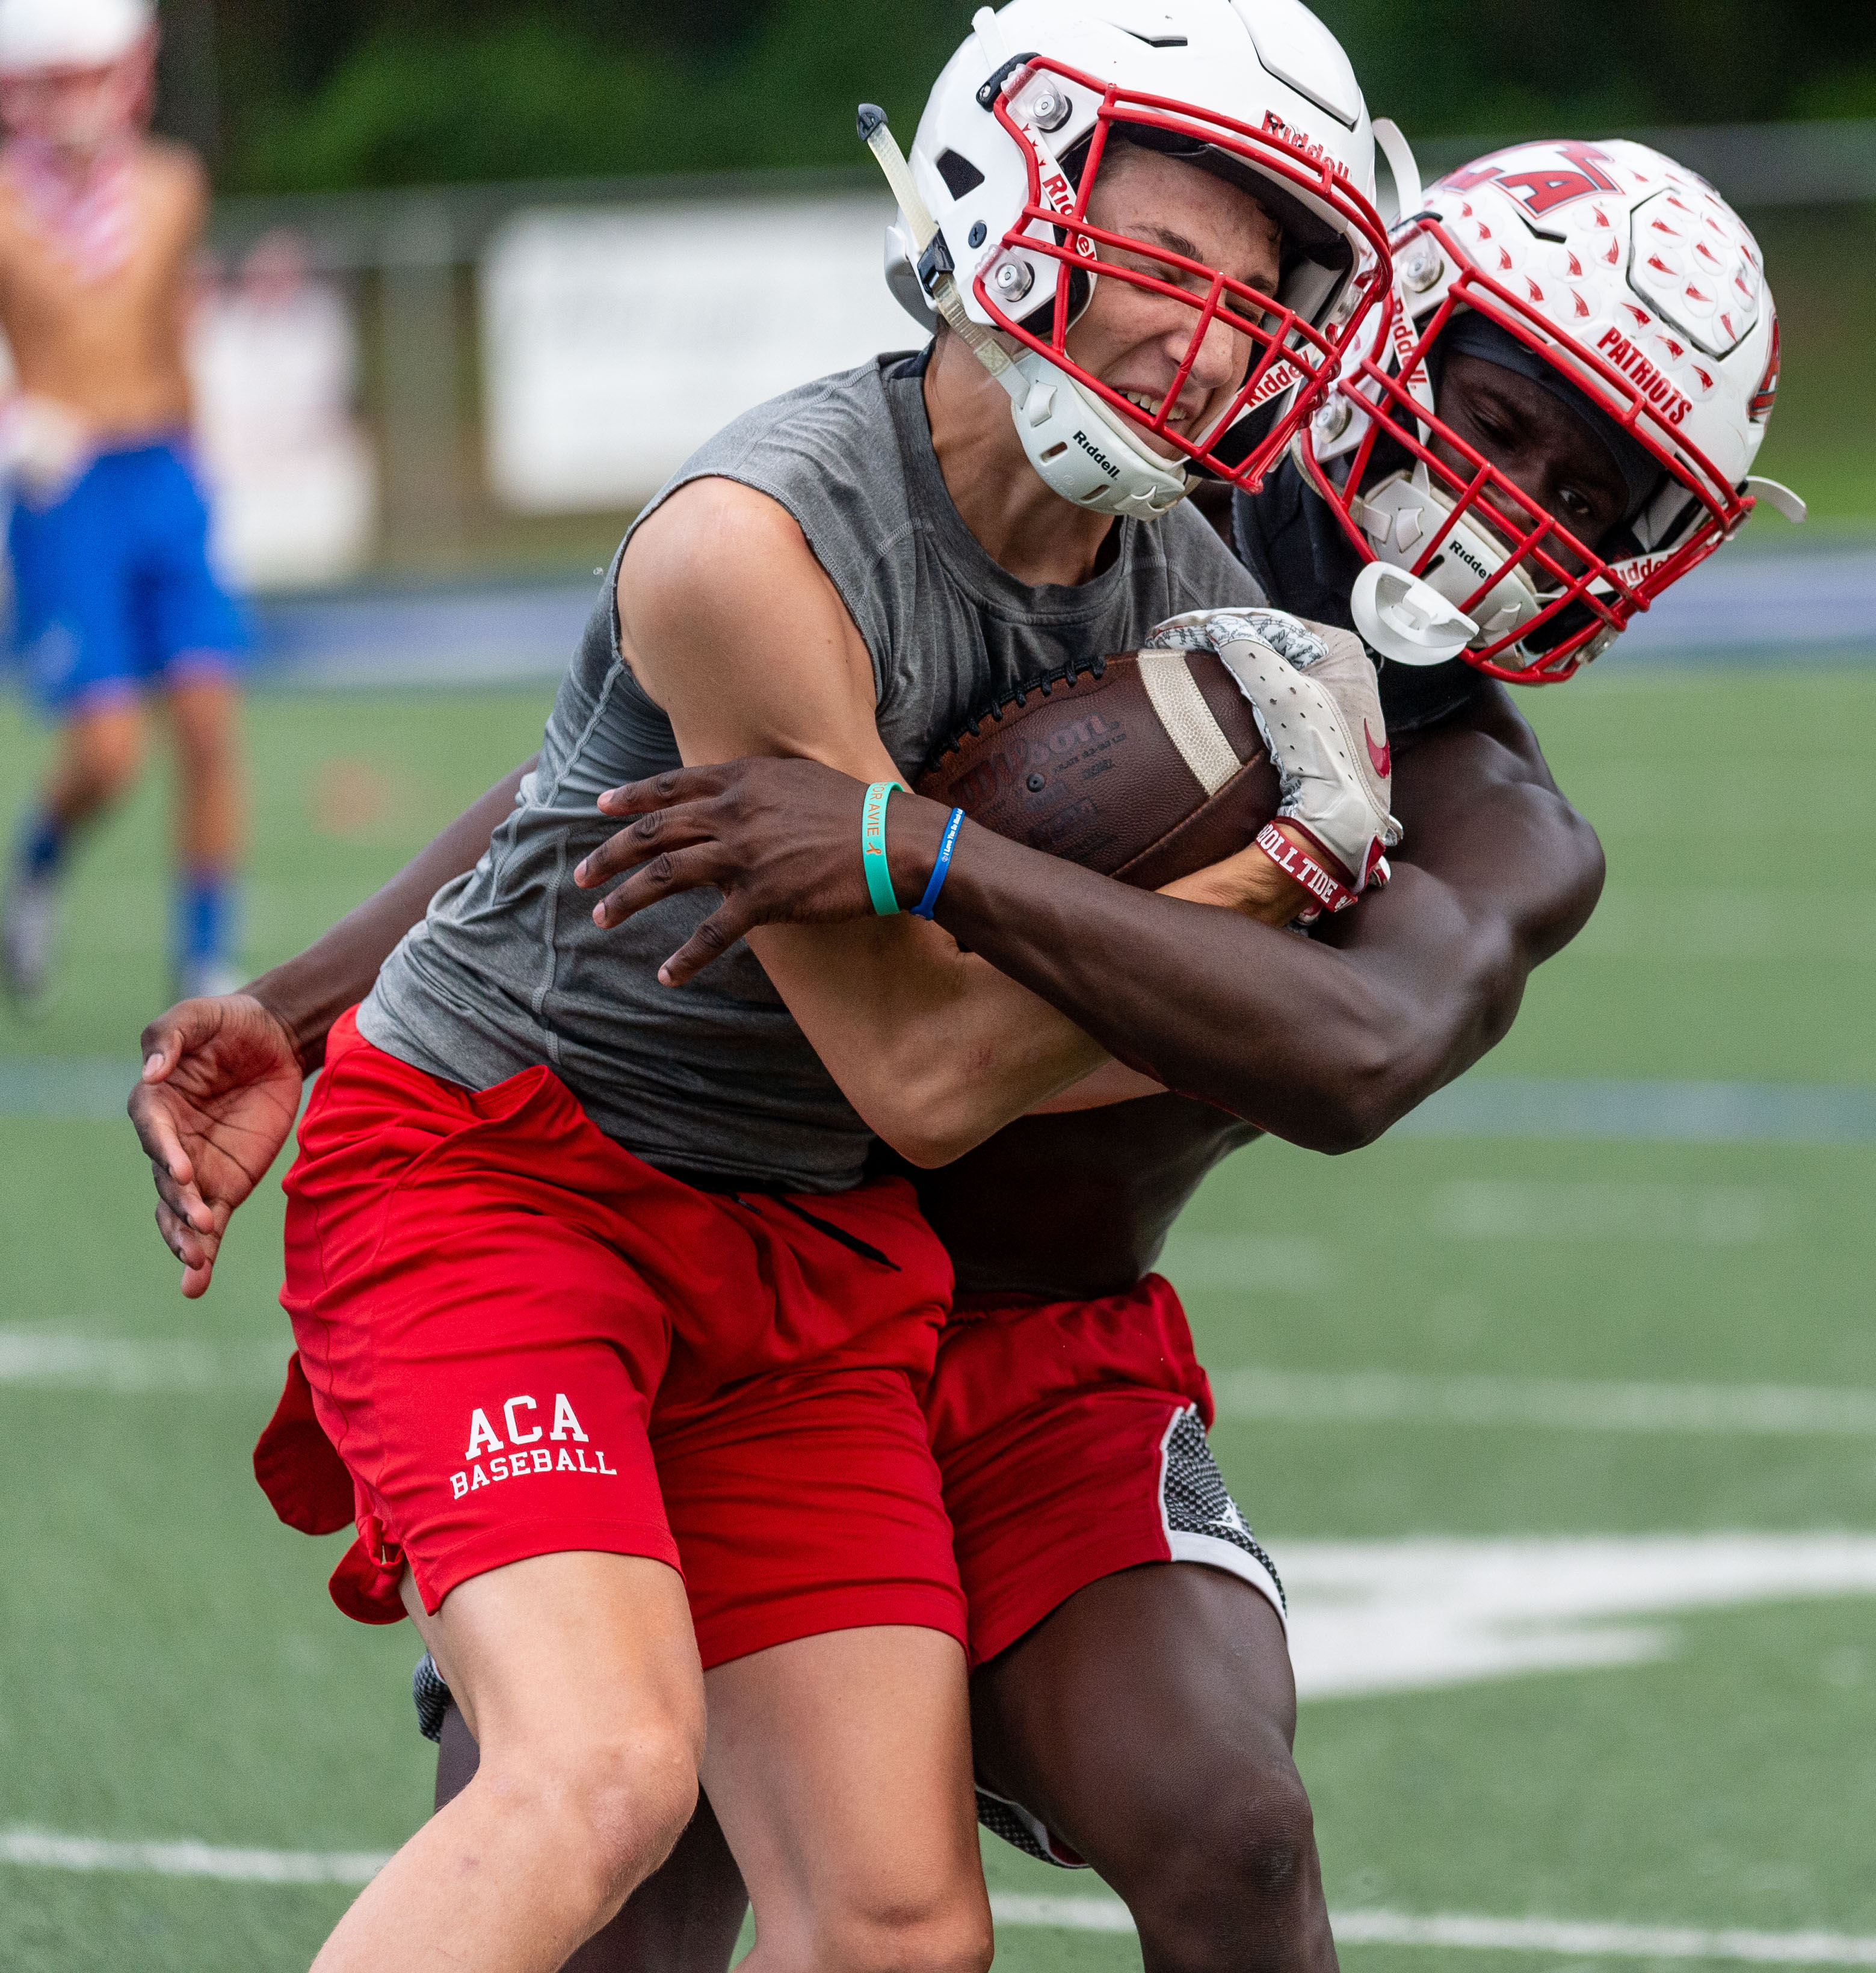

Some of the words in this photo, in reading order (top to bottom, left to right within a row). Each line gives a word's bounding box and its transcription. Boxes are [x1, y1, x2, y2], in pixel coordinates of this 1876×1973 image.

[1596, 326, 1692, 425] PATRIOTS
[1072, 430, 1121, 478] Riddell
[1449, 540, 1492, 582] Riddel
[867, 803, 880, 837] AVIE
[947, 830, 955, 839] You
[943, 839, 952, 852] Love
[1296, 857, 1339, 903] TIDE
[465, 1393, 589, 1461] ACA
[450, 1448, 617, 1500] BASEBALL
